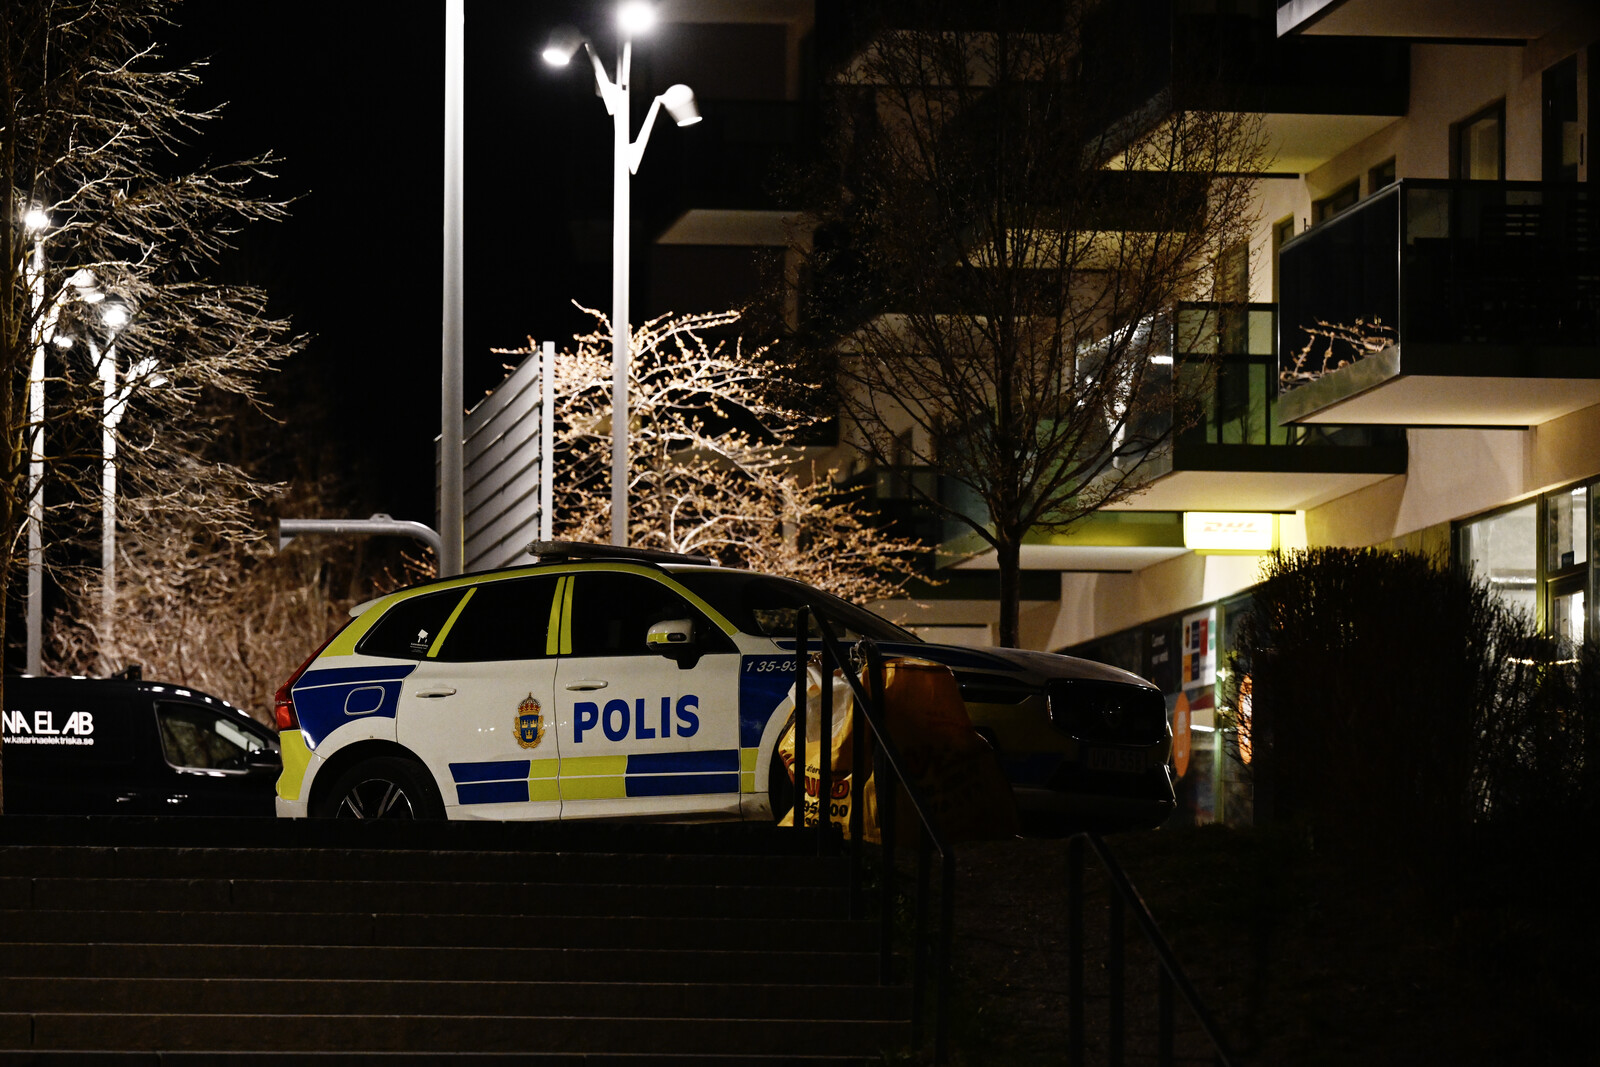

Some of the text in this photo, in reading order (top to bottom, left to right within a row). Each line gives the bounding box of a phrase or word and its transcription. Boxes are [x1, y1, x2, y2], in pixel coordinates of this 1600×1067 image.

[746, 660, 754, 673] 1
[2, 710, 94, 735] NA EL AB
[573, 694, 700, 743] POLIS
